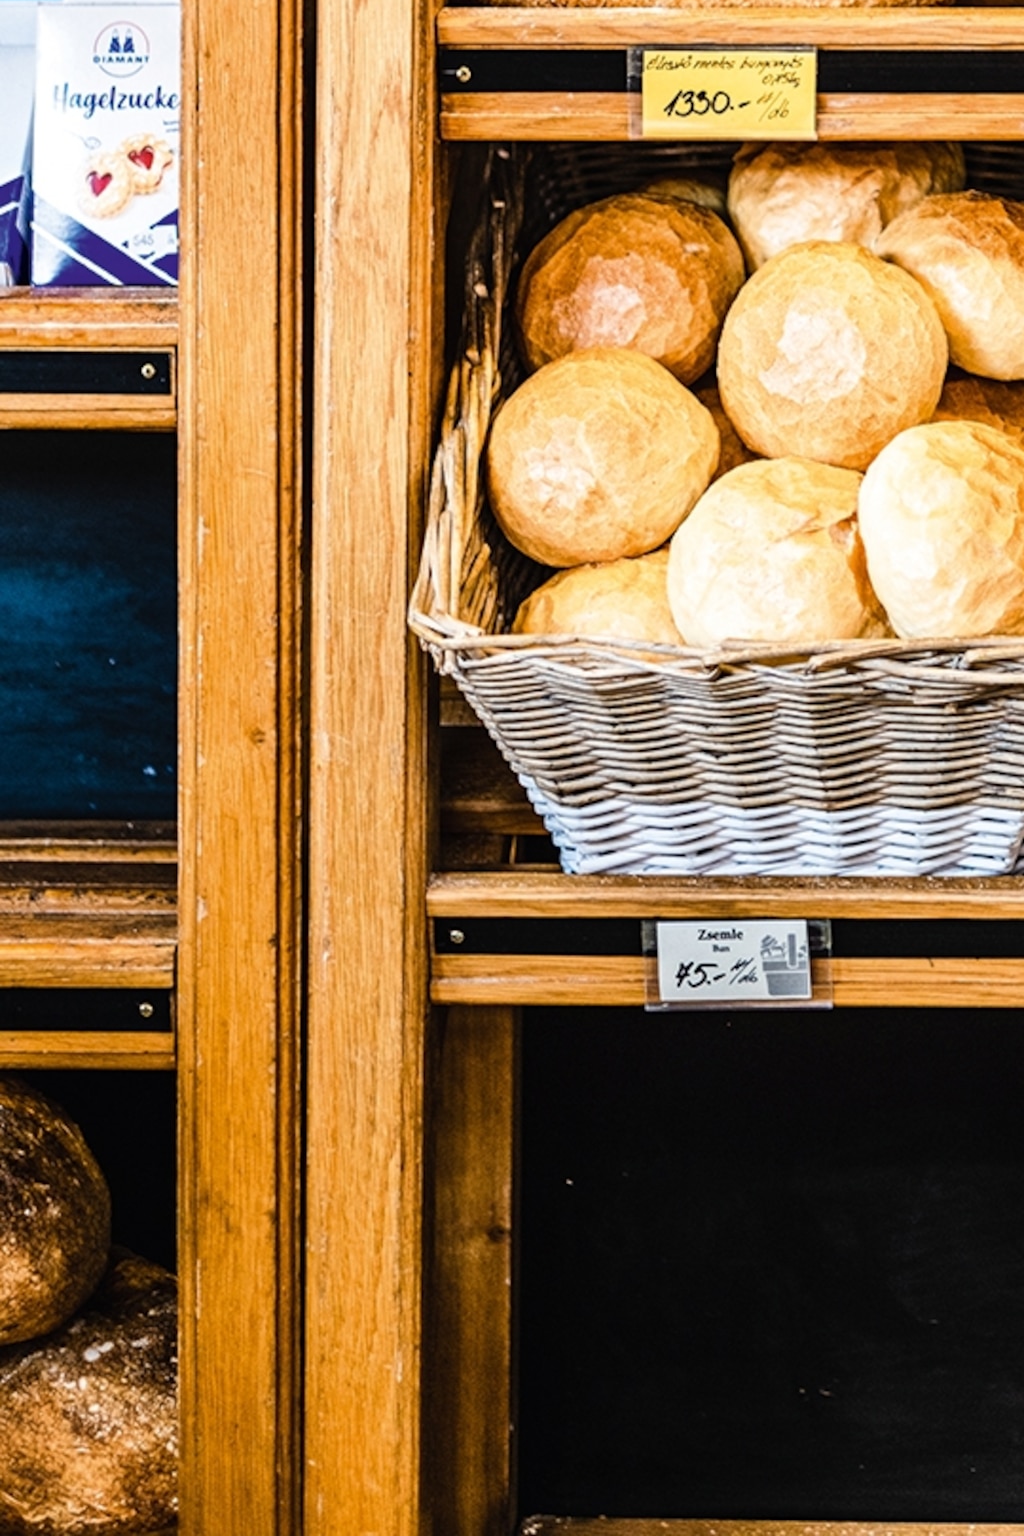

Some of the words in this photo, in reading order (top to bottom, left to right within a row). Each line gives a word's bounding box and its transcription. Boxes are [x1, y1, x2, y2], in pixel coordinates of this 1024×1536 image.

[92, 55, 150, 64] DIAMANT
[53, 82, 179, 119] Hagelzucke
[697, 929, 744, 941] Zsemle
[712, 944, 731, 953] Bun
